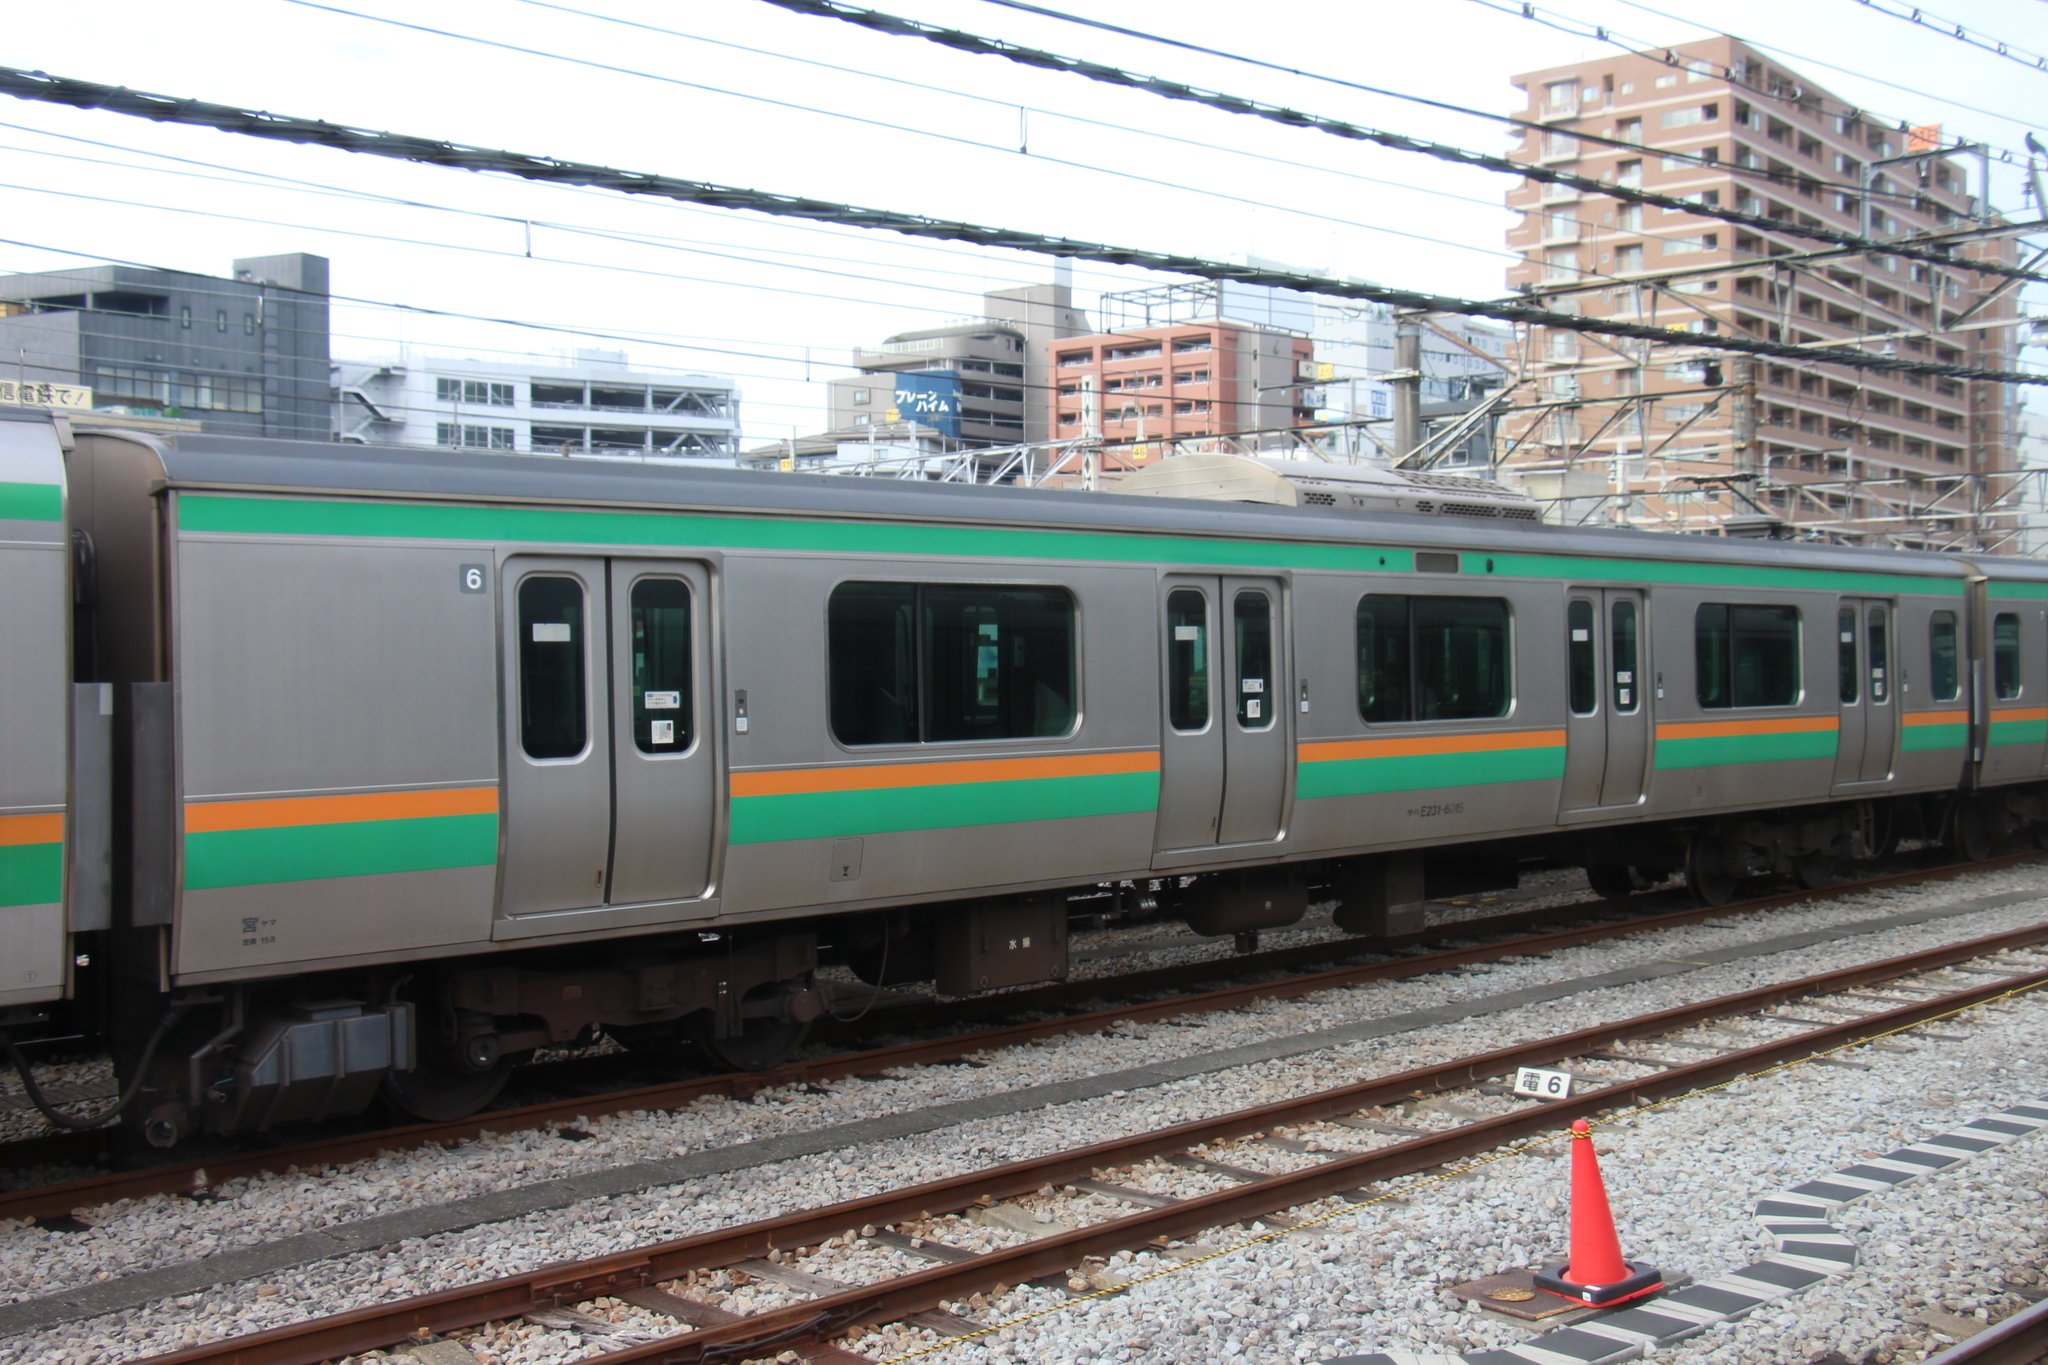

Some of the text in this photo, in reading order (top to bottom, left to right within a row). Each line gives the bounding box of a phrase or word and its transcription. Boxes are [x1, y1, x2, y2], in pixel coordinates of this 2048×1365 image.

[915, 400, 949, 412] ハイム
[466, 568, 482, 590] 6
[1522, 1071, 1562, 1094] 電 6
